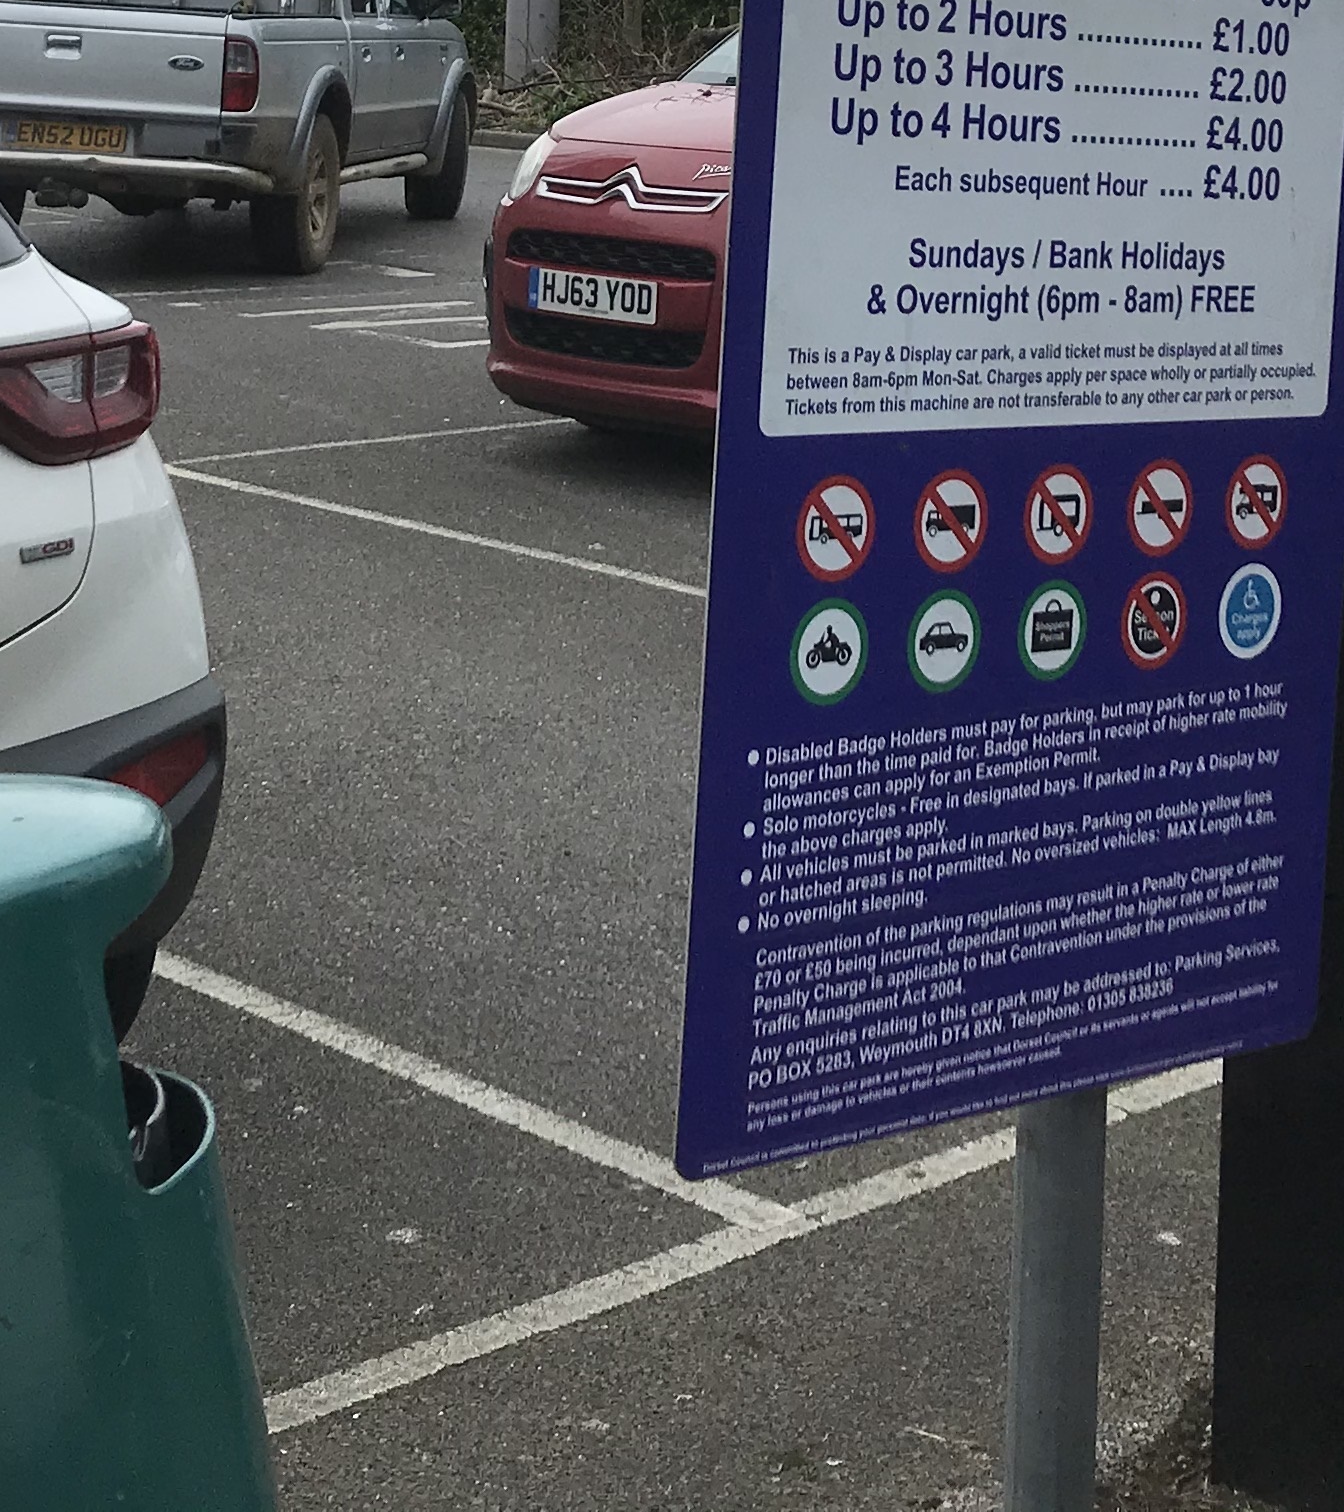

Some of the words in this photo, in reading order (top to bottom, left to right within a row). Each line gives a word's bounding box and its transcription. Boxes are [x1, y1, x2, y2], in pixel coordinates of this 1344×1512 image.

[1211, 16, 1291, 57] £1.00
[832, 42, 883, 92] Up
[891, 45, 928, 85] to
[934, 48, 955, 87] 3
[965, 50, 1065, 93] Hours
[1208, 65, 1287, 105] £2.00
[16, 121, 73, 146] EN52
[829, 96, 880, 146] Up
[888, 99, 925, 138] to
[930, 101, 953, 139] 4
[962, 102, 1062, 143] Hours
[1205, 114, 1284, 153] £4.00
[894, 165, 953, 192] Each
[958, 167, 1091, 201] subsequent
[1095, 172, 1149, 197] Hour
[1202, 163, 1281, 201] £4.00
[907, 238, 1026, 276] Sundays
[1031, 240, 1042, 269] /
[1048, 240, 1114, 269] Bank
[1120, 241, 1226, 277] Holidays
[542, 271, 599, 308] HJ63
[605, 279, 652, 316] YOD
[866, 284, 888, 314] &
[895, 284, 1030, 321] Overnight
[1036, 285, 1101, 321] (6pm
[1122, 285, 1184, 320] 8am)
[1190, 285, 1256, 313] FREE
[786, 345, 821, 364] This
[823, 345, 838, 363] is
[840, 349, 850, 363] a
[853, 345, 881, 367] Pay
[884, 344, 896, 362] &
[899, 344, 953, 366] Display
[954, 347, 978, 361] car
[980, 343, 1015, 364] park,
[1017, 346, 1027, 360] a
[1029, 342, 1062, 359] valid
[1064, 342, 1101, 359] ticket
[1103, 341, 1136, 358] must
[1138, 341, 1155, 358] be
[1156, 340, 1217, 361] displayed
[1218, 340, 1232, 356] at
[1233, 340, 1249, 356] all
[1250, 339, 1284, 356] times
[785, 370, 849, 389] between
[851, 369, 919, 392] 8am-6pm
[921, 368, 984, 386] Mon-Sat.
[985, 366, 1043, 388] Charges
[1045, 366, 1083, 387] apply
[1084, 369, 1107, 386] per
[1109, 368, 1148, 385] space
[1149, 363, 1191, 384] wholly
[1192, 367, 1207, 379] or
[1208, 362, 1258, 383] partially
[1259, 361, 1317, 382] occupied.
[784, 396, 839, 415] Tickets
[841, 395, 876, 413] from
[878, 394, 907, 412] this
[909, 392, 970, 411] machine
[972, 395, 995, 409] are
[997, 391, 1021, 408] not
[1022, 389, 1102, 407] transferable
[1104, 388, 1119, 405] to
[1120, 391, 1144, 408] any
[1146, 387, 1181, 404] other
[1182, 389, 1203, 403] car
[1204, 385, 1233, 406] park
[1234, 388, 1248, 401] or
[1249, 387, 1294, 404] person.
[1134, 609, 1175, 624] Seon
[765, 738, 834, 765] Disabled
[837, 731, 887, 759] Badge
[889, 723, 948, 748] Holders
[950, 717, 988, 739] must
[990, 717, 1017, 738] pay
[1018, 710, 1040, 730] for
[1100, 699, 1124, 719] but
[1125, 699, 1154, 719] may
[1155, 691, 1186, 715] park
[1187, 688, 1207, 707] for
[1208, 689, 1226, 708] up
[1227, 684, 1242, 701] to
[1243, 682, 1250, 699] 1
[1253, 678, 1283, 698] hour
[760, 837, 787, 859] the
[790, 830, 838, 854] above
[840, 820, 902, 851] charges
[904, 813, 949, 841] apply.
[756, 908, 780, 930] No
[783, 895, 858, 929] overnight
[751, 1011, 801, 1039] Traffic
[803, 991, 899, 1032] Management
[901, 985, 927, 1007] Act
